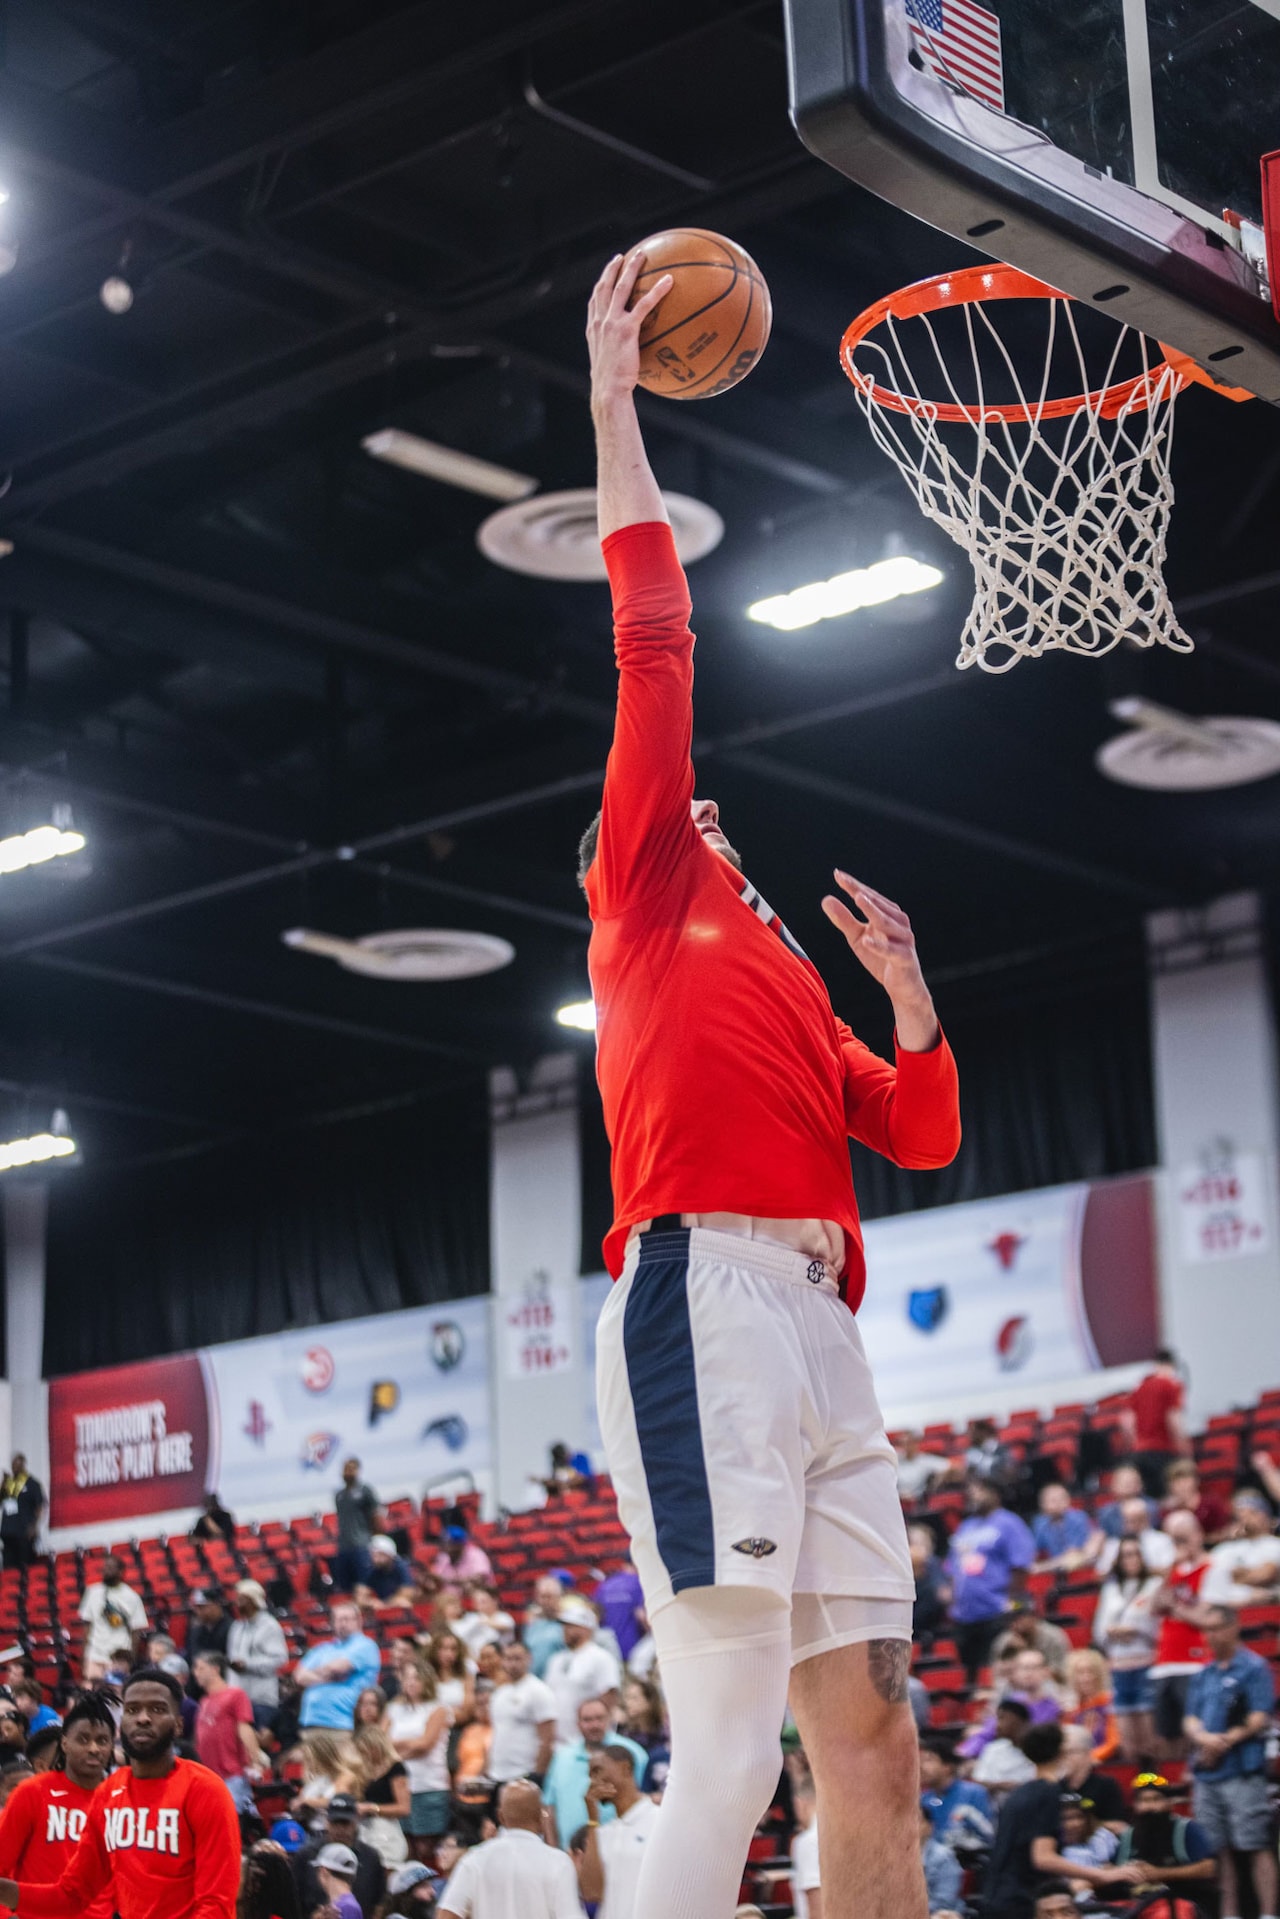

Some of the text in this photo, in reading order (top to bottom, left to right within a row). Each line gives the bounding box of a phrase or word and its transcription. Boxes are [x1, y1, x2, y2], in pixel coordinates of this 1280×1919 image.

[74, 1399, 166, 1449] TOMORROW'S
[74, 1431, 193, 1488] STARS PLAY HERE
[104, 1807, 180, 1855] NOLA
